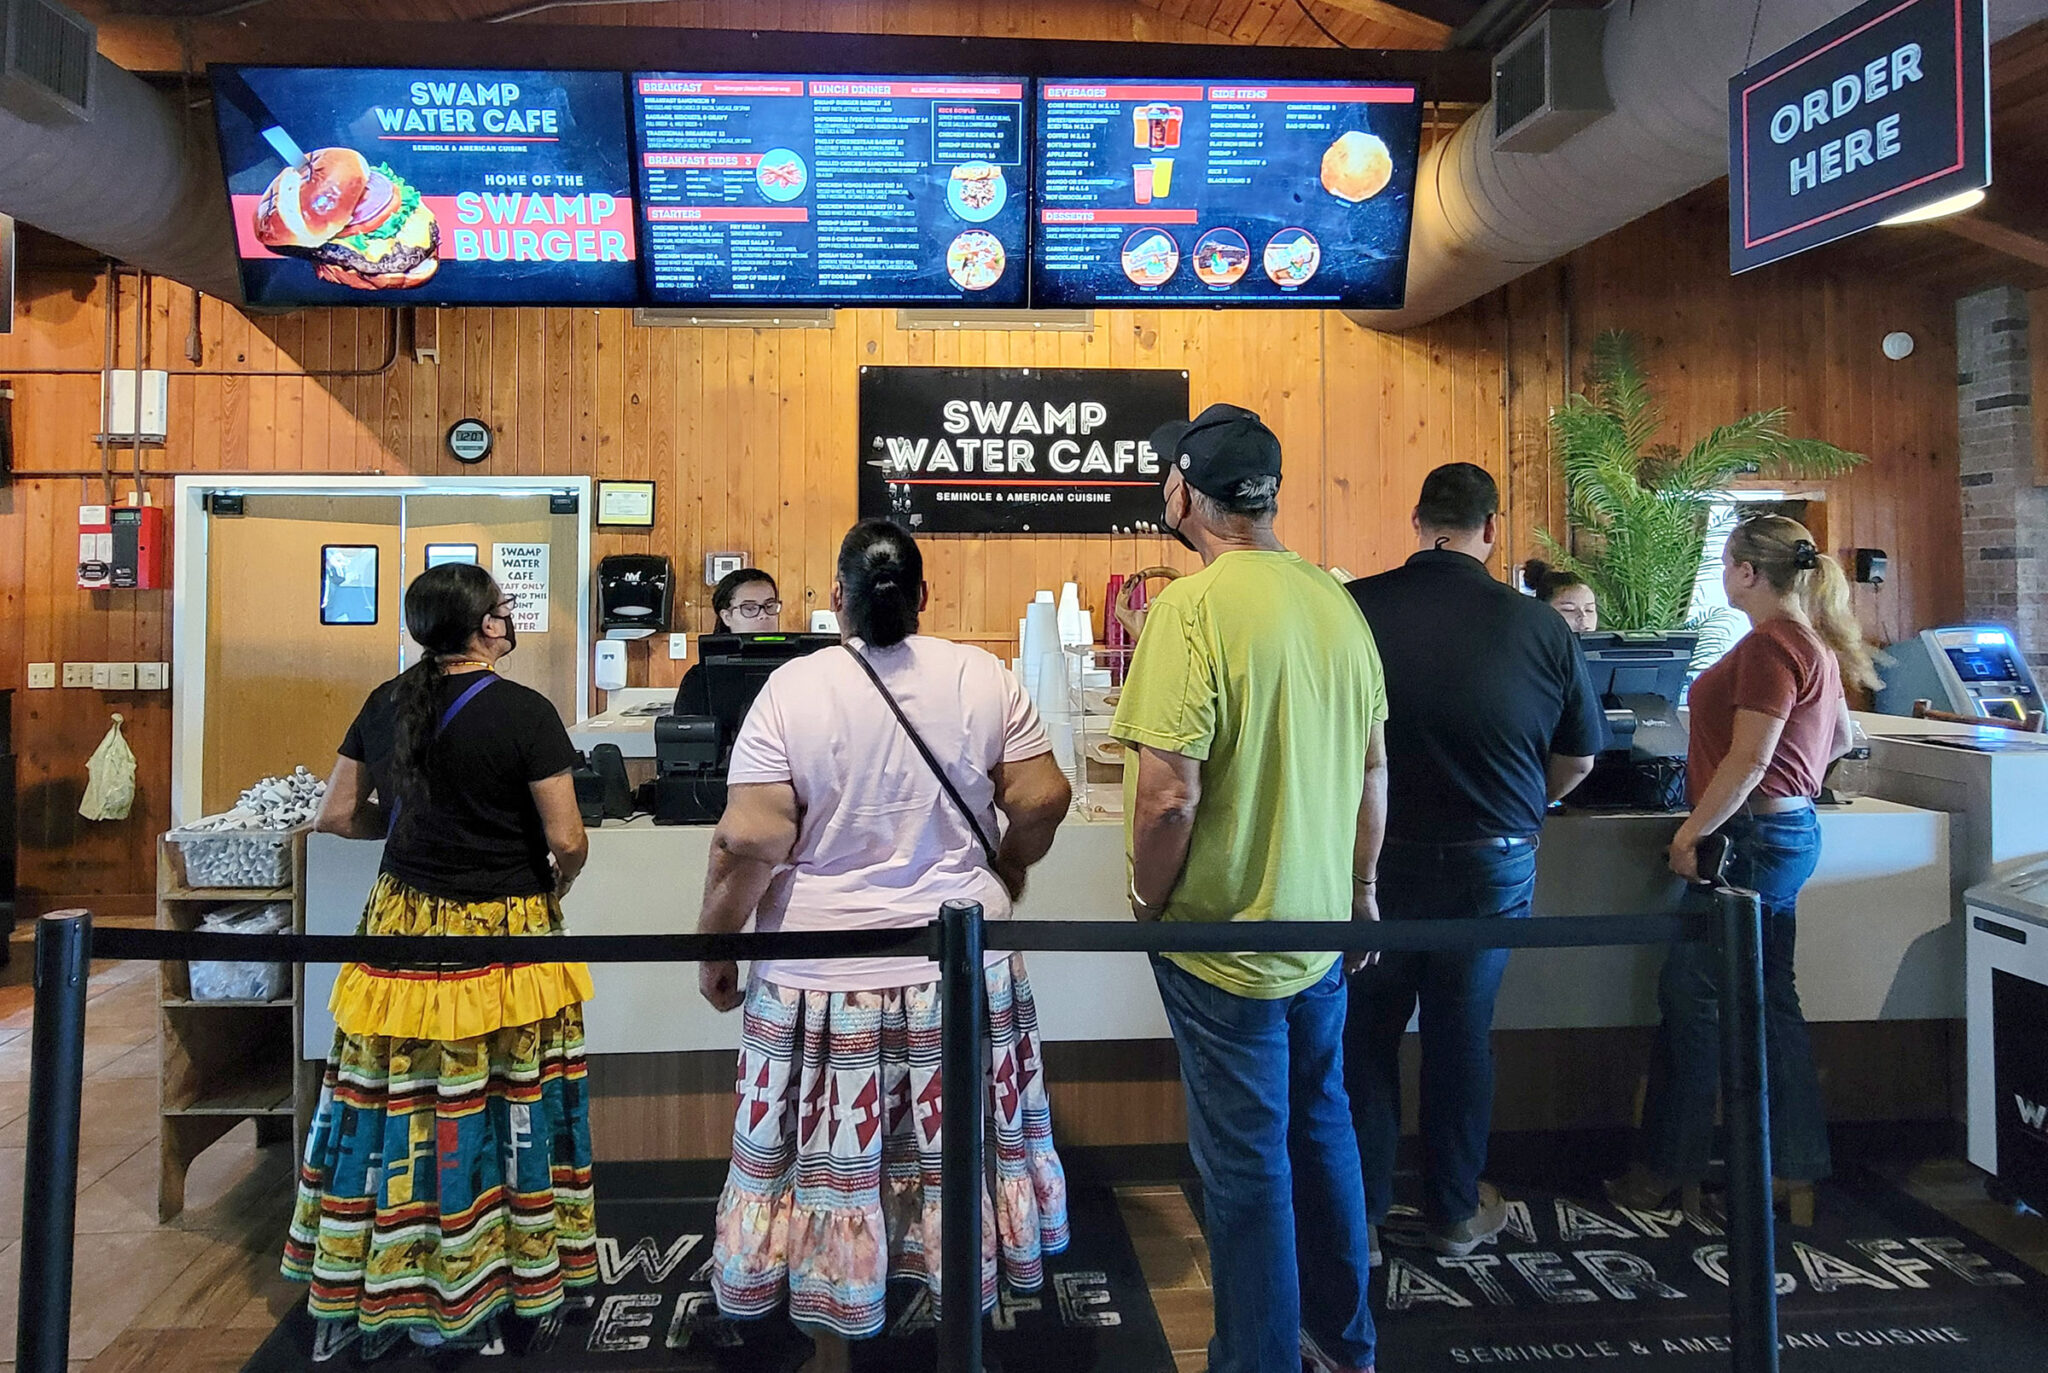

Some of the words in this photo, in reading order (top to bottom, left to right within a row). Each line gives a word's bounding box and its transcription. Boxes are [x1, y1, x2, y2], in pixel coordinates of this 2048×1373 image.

[409, 81, 520, 106] SWAMP
[643, 83, 702, 93] BREAKFAST
[813, 85, 849, 94] LUNCH
[851, 85, 891, 95] DINNER
[1047, 88, 1107, 98] BEVERAGES
[1770, 42, 1924, 144] ORDER
[1211, 90, 1235, 98] SIDE
[1236, 90, 1267, 99] ITEMS
[376, 108, 474, 132] WATER
[482, 108, 559, 134] CAFE
[497, 145, 528, 153] CUISINE
[1789, 113, 1901, 196] HERE
[648, 156, 707, 165] BREAKFAST
[708, 156, 739, 166] SIDES
[745, 156, 752, 166] 3
[485, 174, 527, 186] HOME
[531, 174, 549, 186] OF
[553, 174, 584, 186] THE
[455, 191, 616, 225] SWAMP
[651, 209, 702, 219] STARTERS
[1046, 212, 1095, 221] DESSERTS
[453, 229, 628, 262] BURGER
[943, 400, 1107, 435] SWAMP
[886, 438, 1036, 474] WATER
[1048, 439, 1161, 474] CAFE
[936, 491, 993, 502] SEMINOLE
[995, 492, 1004, 502] &
[1006, 492, 1065, 503] AMERICAN
[1067, 492, 1112, 503] CUISINE
[501, 547, 542, 557] SWAMP
[502, 559, 540, 568] WATER
[508, 571, 534, 580] CAFE
[518, 612, 540, 620] NOT
[1385, 1247, 1690, 1310] ATER
[1449, 1340, 1620, 1364] SEMINOLE
[1628, 1340, 1652, 1355] &
[1835, 1327, 1969, 1347] CUISINE
